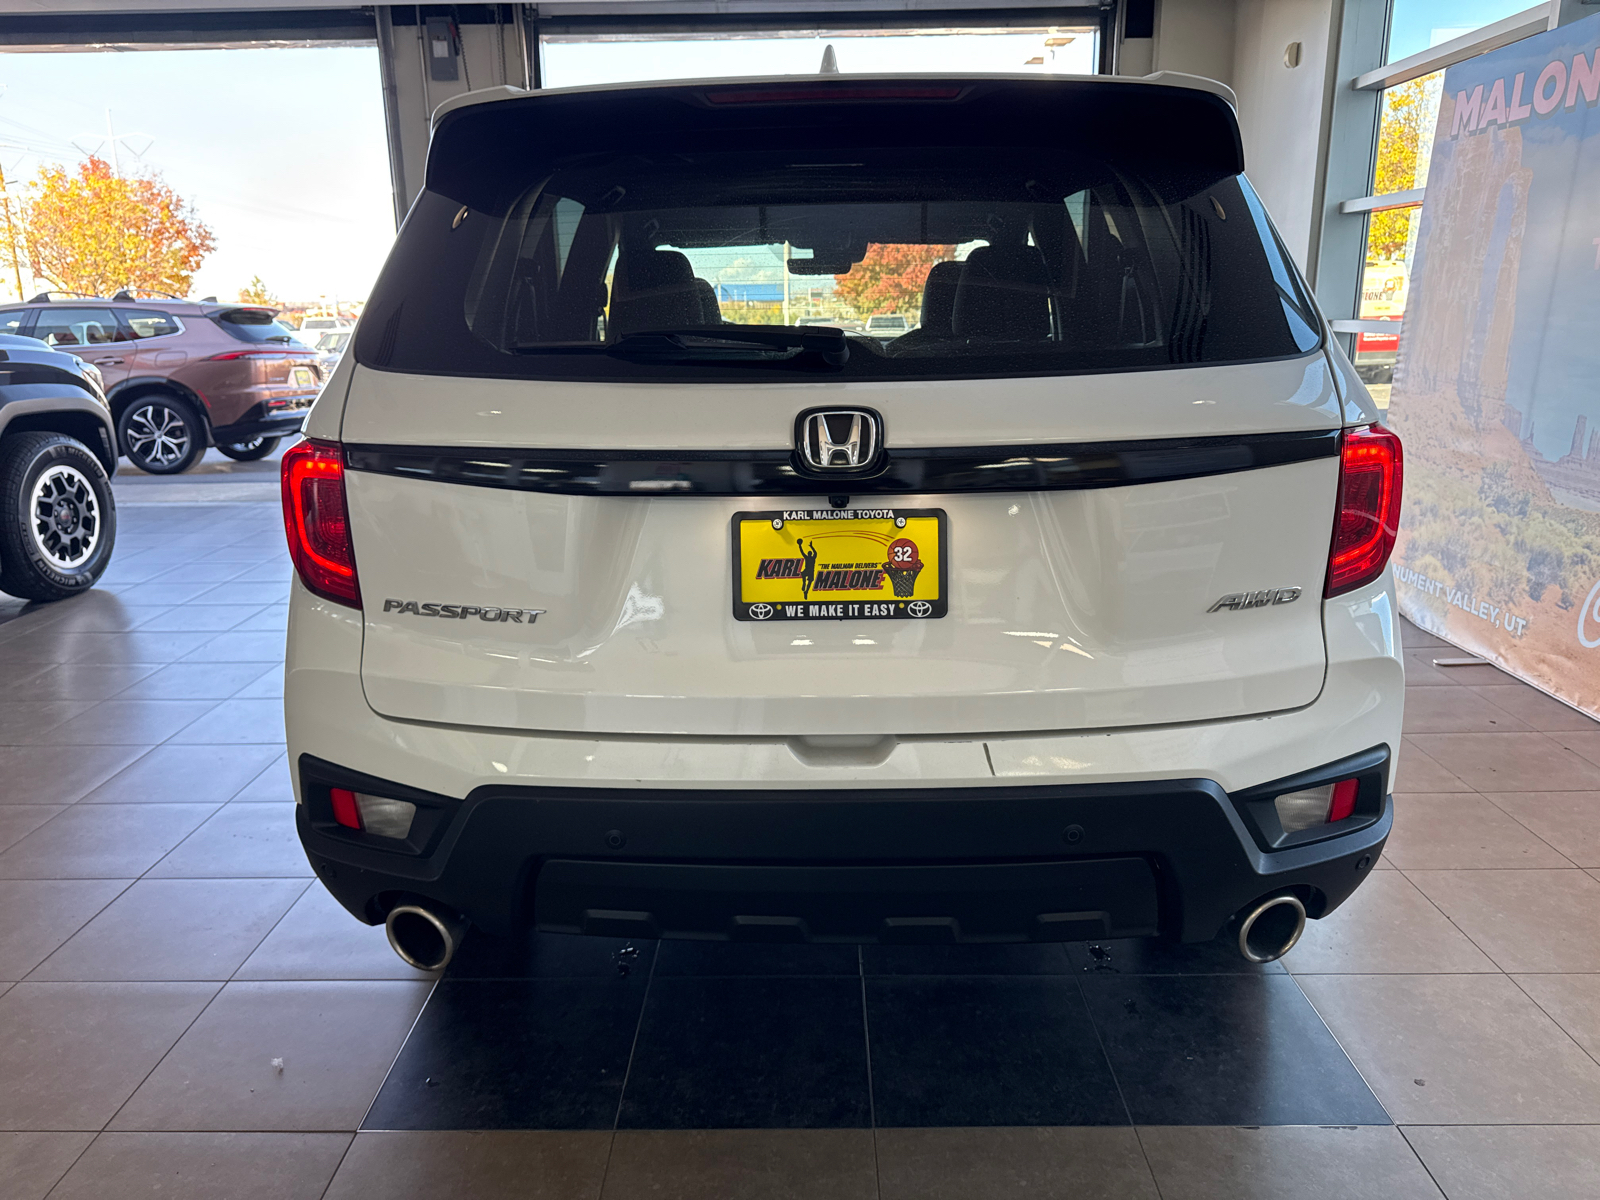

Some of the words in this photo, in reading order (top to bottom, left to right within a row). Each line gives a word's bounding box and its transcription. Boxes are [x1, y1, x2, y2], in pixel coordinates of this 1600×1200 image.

[67, 447, 103, 479] MICHELIN
[783, 511, 810, 520] KARL
[813, 510, 854, 520] MALONE
[856, 509, 894, 519] TOYOTA
[893, 546, 912, 562] 32
[36, 558, 77, 586] MICHELIN
[756, 558, 805, 579] KARL
[812, 569, 886, 591] MALONE
[383, 597, 547, 624] PASSPORT
[785, 605, 804, 617] WE
[809, 605, 844, 617] MAKE
[848, 604, 860, 616] IT
[864, 604, 895, 616] EASY
[1206, 586, 1302, 613] AWD
[1446, 587, 1501, 629] VALLEY,
[1504, 612, 1526, 635] UT
